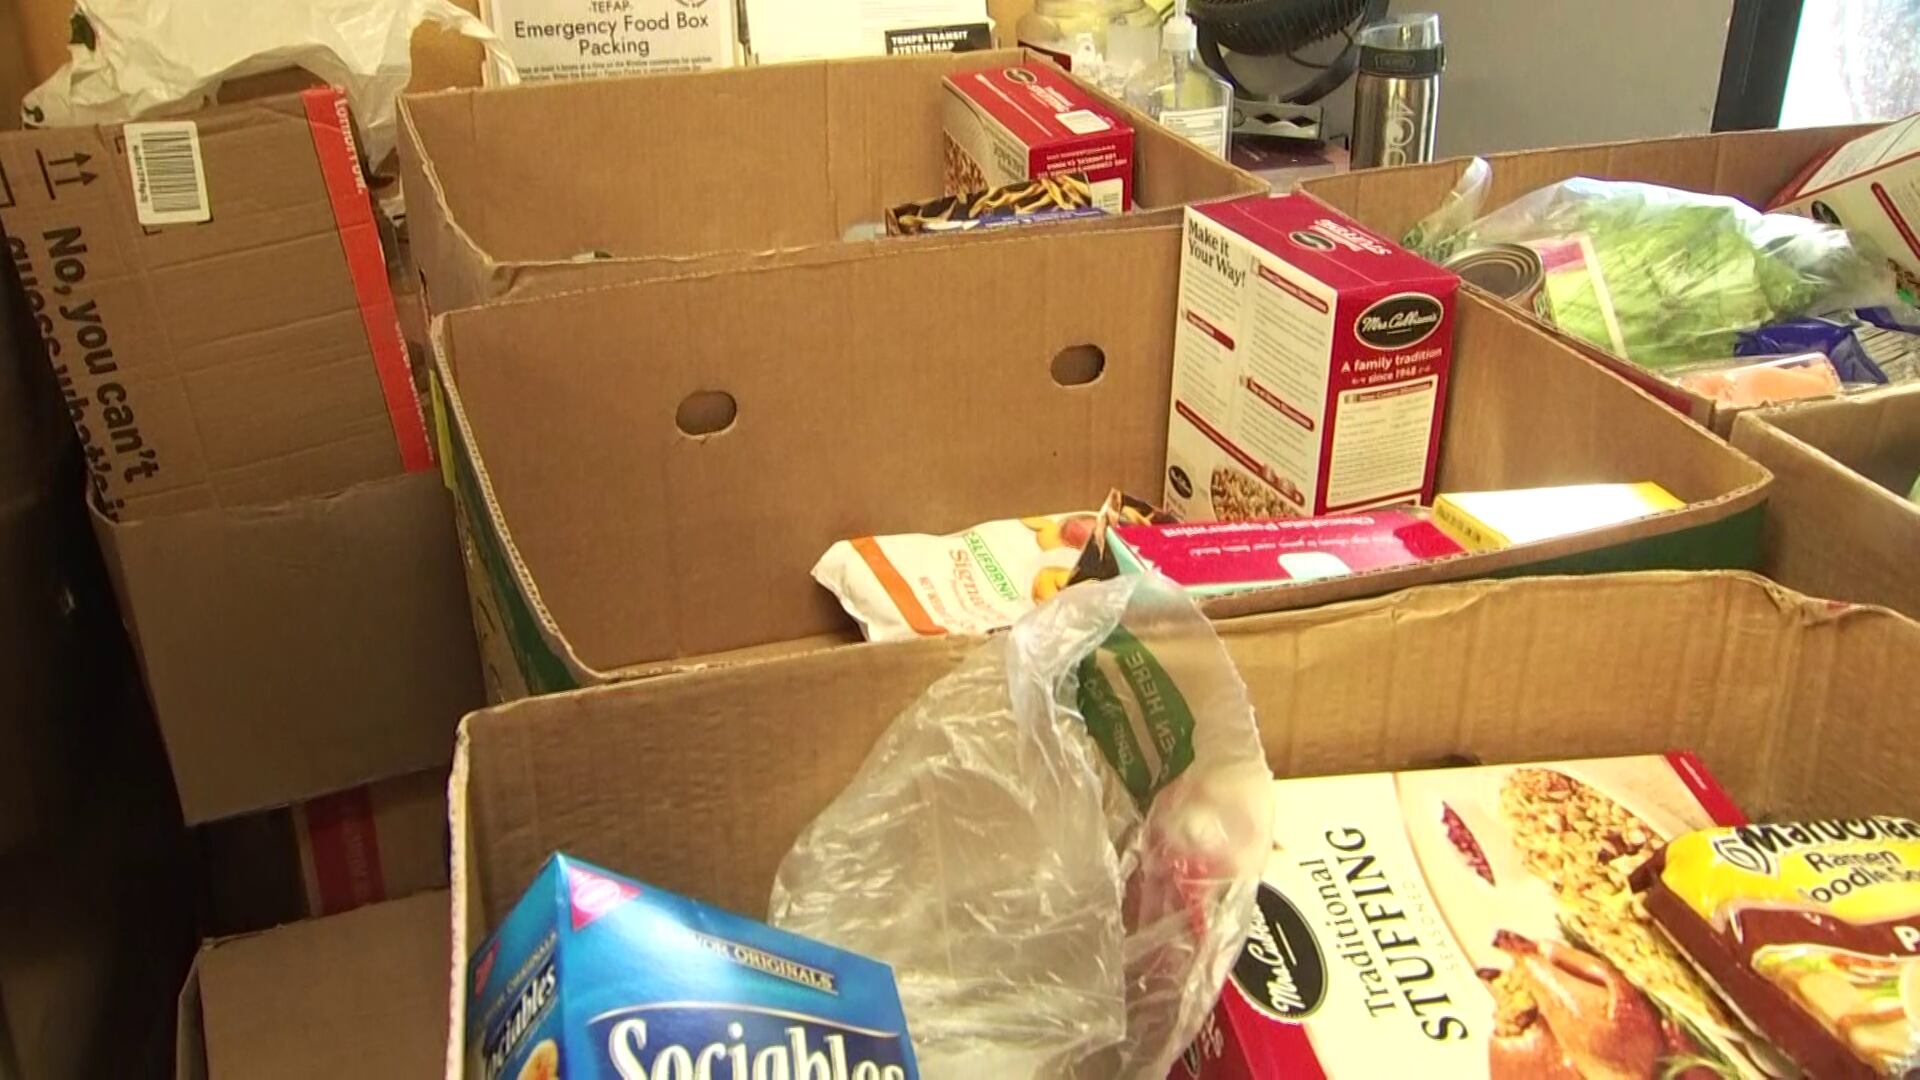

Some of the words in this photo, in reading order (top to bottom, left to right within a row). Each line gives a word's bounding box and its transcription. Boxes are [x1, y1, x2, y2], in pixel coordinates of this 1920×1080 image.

[514, 19, 617, 40] Emergency
[624, 12, 670, 31] Food
[677, 11, 709, 29] Box
[579, 37, 650, 57] Packing
[926, 30, 968, 41] TRANSIT
[1188, 218, 1218, 249] Make
[1220, 237, 1230, 257] it
[43, 226, 88, 296] No,
[1188, 237, 1214, 268] Your
[1216, 255, 1246, 288] Way!
[59, 299, 118, 375] you
[1341, 361, 1351, 373] A
[1354, 356, 1393, 372] family
[1395, 347, 1442, 366] tradition
[1368, 372, 1394, 384] since
[97, 382, 159, 483] can't
[1299, 858, 1396, 1018] Traditional
[1325, 827, 1469, 1041] STUFFING
[734, 946, 834, 991] ORIGINALS
